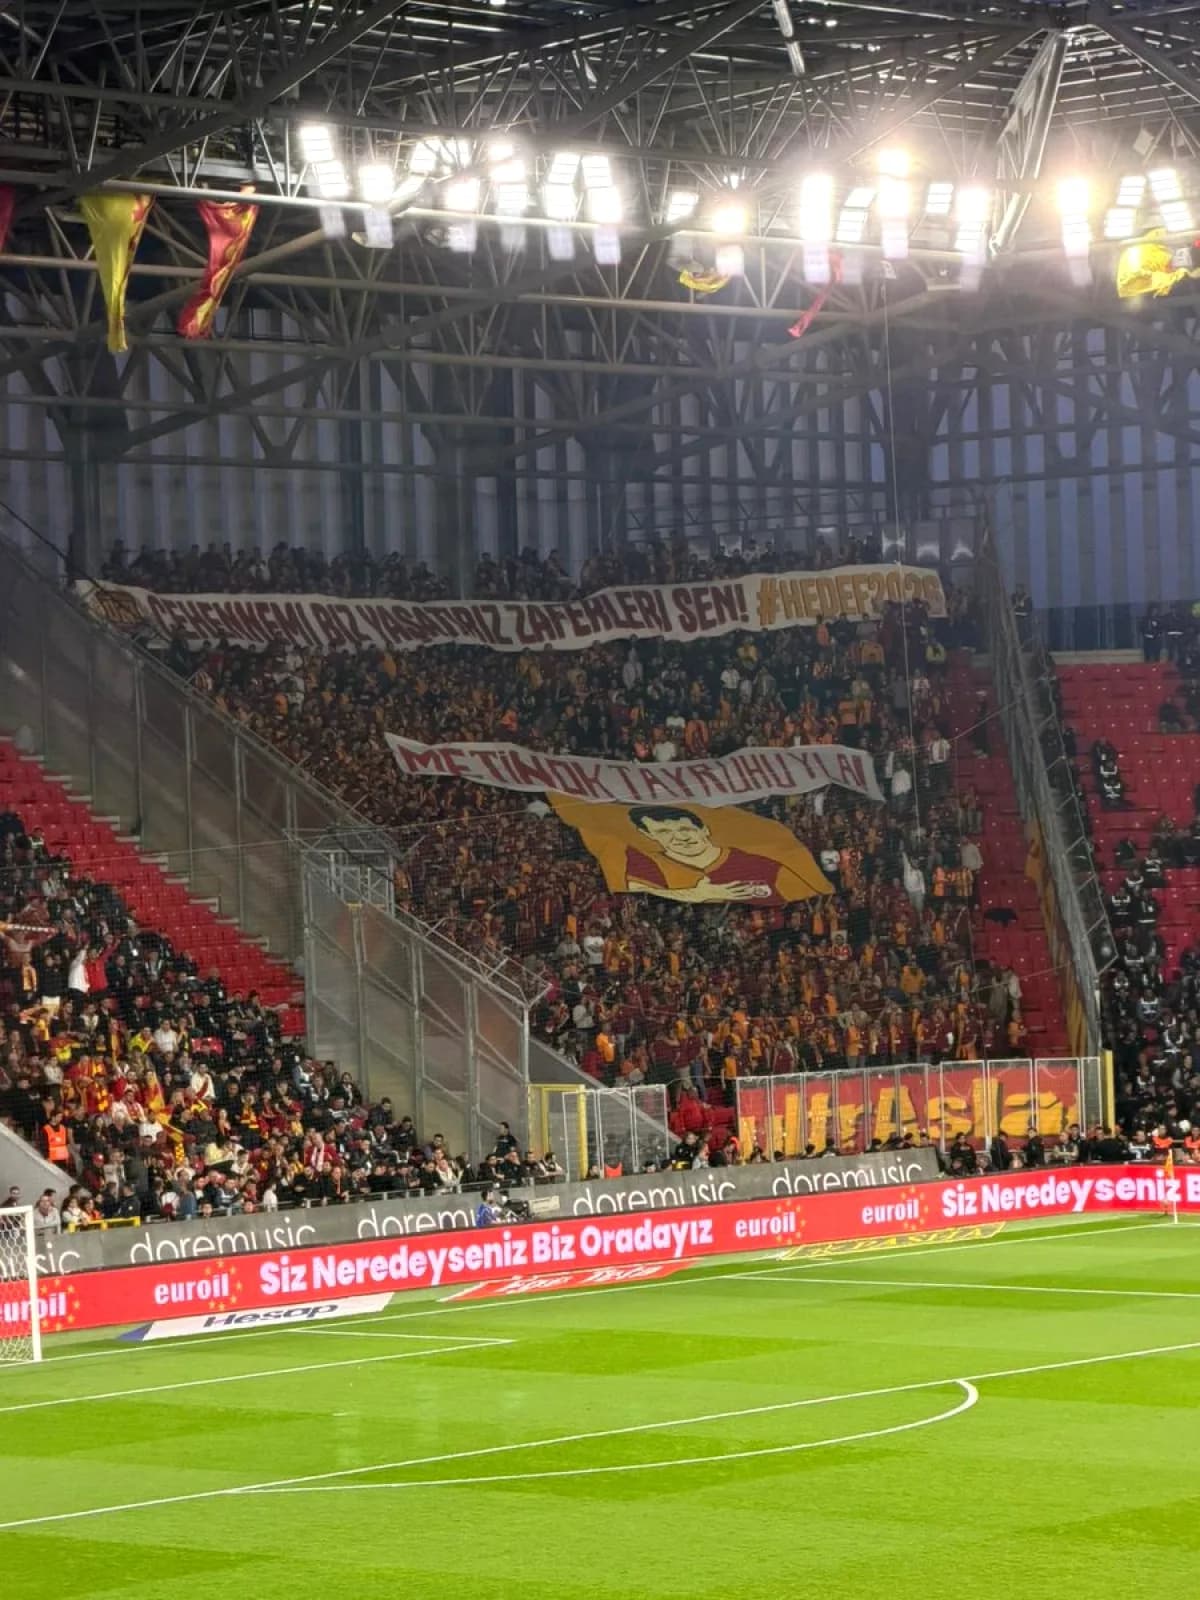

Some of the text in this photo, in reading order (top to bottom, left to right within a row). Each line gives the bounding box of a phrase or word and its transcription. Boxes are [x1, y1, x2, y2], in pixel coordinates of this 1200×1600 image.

[672, 583, 749, 633] SEN!
[572, 1174, 736, 1216] doremusic
[772, 1156, 923, 1196] doremusic
[942, 1182, 977, 1219] Siz
[982, 1169, 1182, 1212] Neredeyseniz
[735, 1210, 796, 1239] euroil
[861, 1198, 919, 1226] euroil
[130, 1217, 316, 1263] doremusic
[260, 1254, 307, 1295] Siz
[313, 1231, 526, 1289] Neredeyseniz
[532, 1227, 576, 1254] Biz
[580, 1218, 714, 1258] Oradayız
[0, 1291, 67, 1323] uroil
[154, 1273, 229, 1305] euroil
[203, 1304, 338, 1327] Hesap
